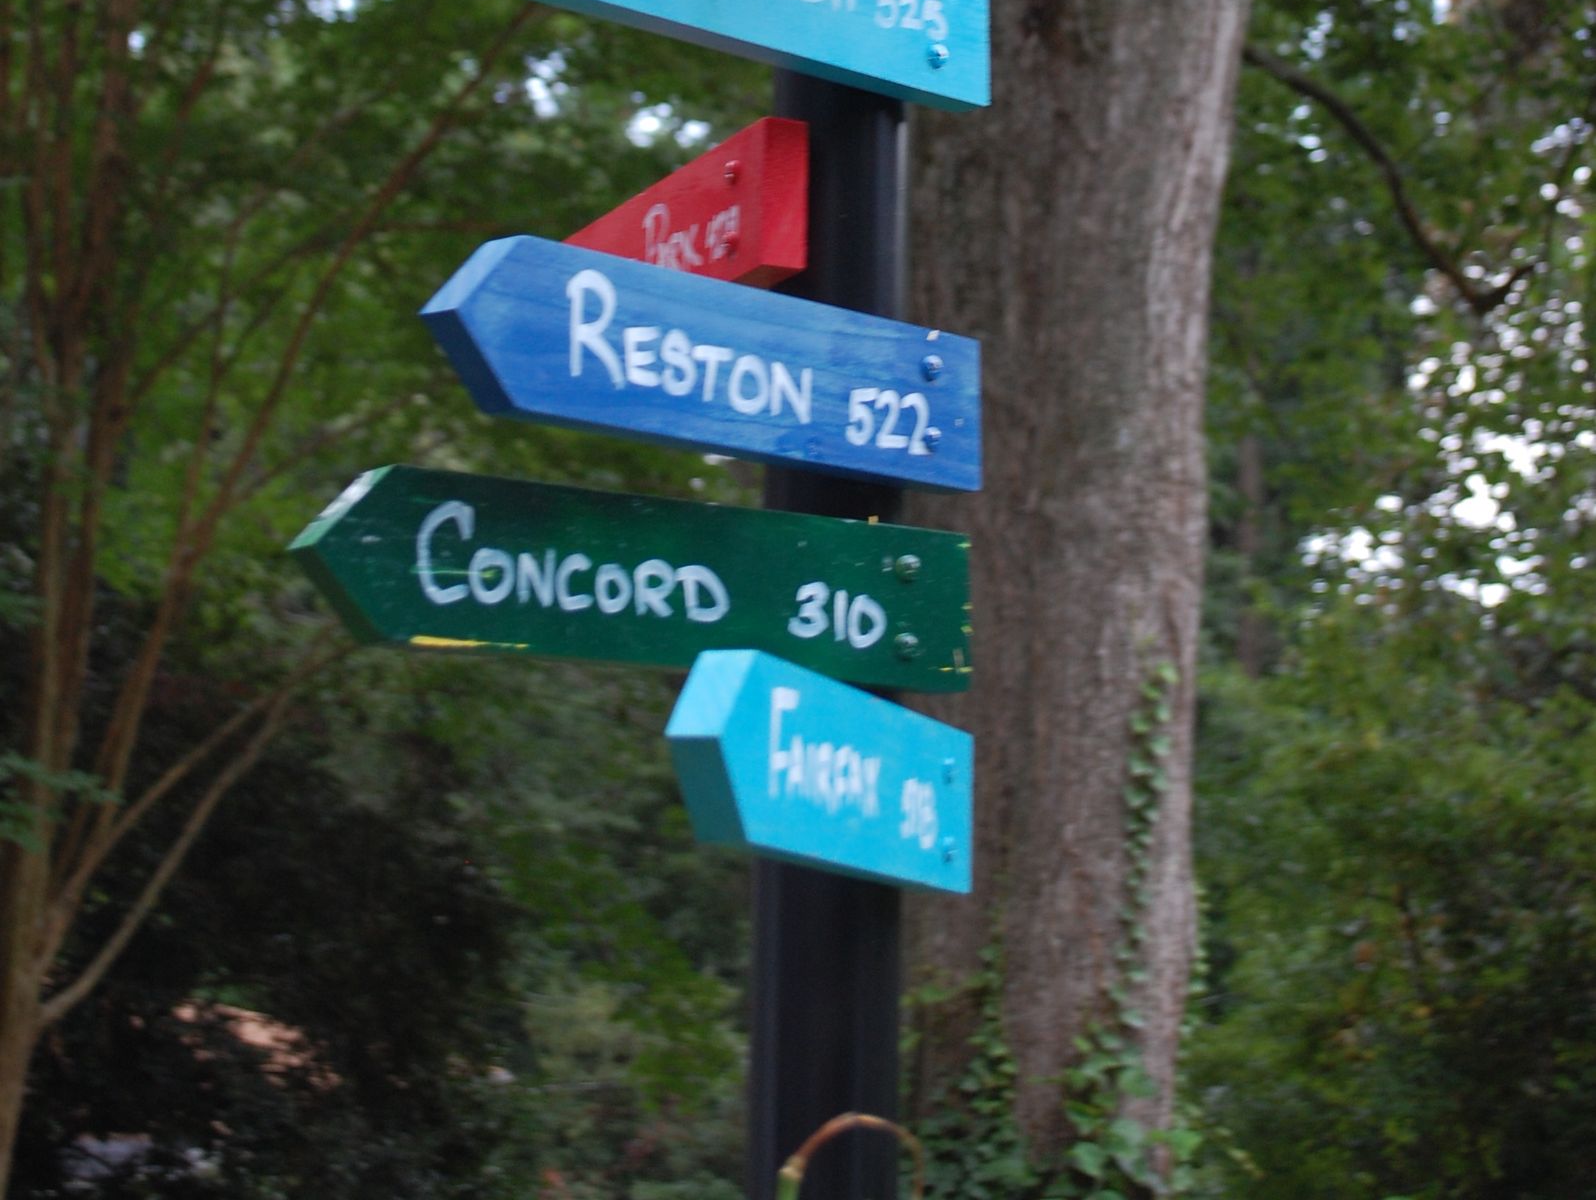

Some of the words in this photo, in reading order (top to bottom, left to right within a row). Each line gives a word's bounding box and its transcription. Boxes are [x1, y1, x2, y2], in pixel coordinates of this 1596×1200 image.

[566, 269, 813, 425] RESTON
[844, 387, 935, 456] 522
[416, 501, 731, 623] CONCORD
[788, 581, 887, 649] 310
